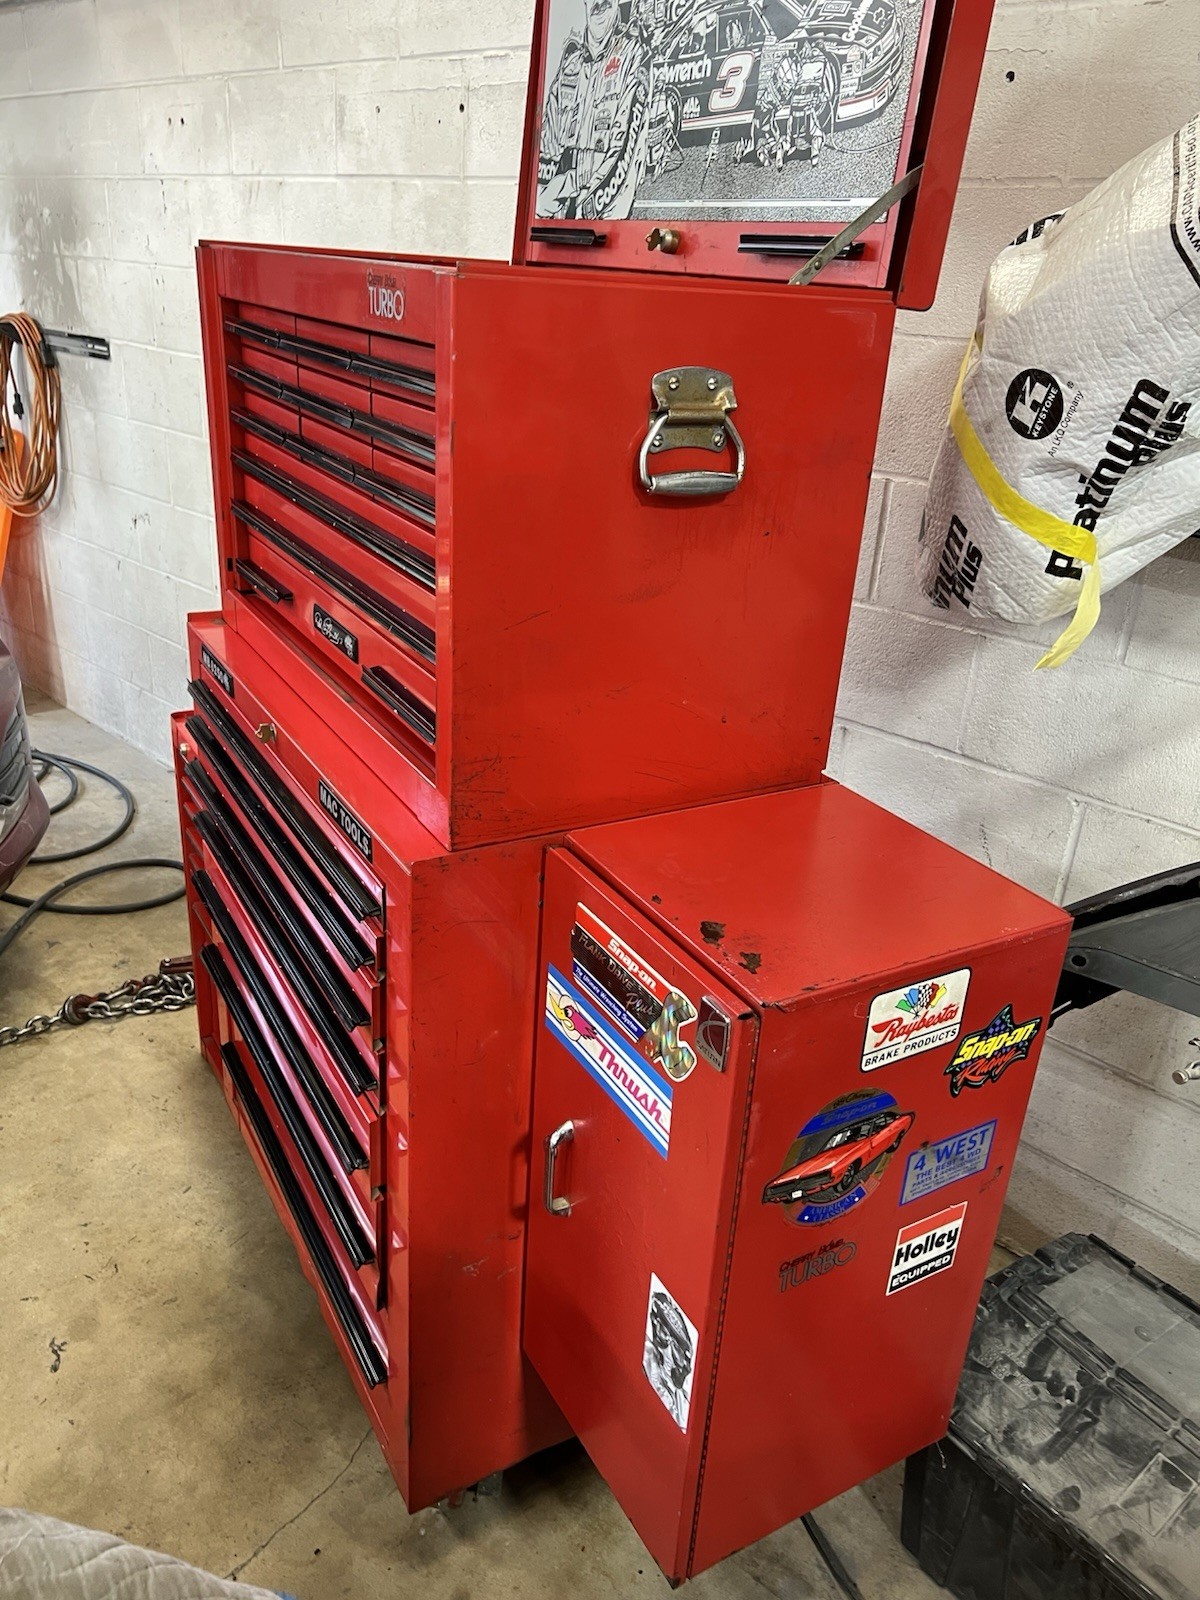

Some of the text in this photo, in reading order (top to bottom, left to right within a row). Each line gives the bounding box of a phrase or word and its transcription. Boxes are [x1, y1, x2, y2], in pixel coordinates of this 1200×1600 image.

[708, 51, 755, 112] 3
[368, 286, 404, 320] TURBO
[1031, 386, 1059, 437] KEYSTONE
[1047, 390, 1084, 458] An LKQ Company
[1045, 379, 1170, 580] patinum
[320, 785, 369, 856] MAC TOOLS
[578, 933, 635, 990] FLANK DRIVE
[864, 1027, 958, 1068] BRAKE PRODUCTS
[871, 1003, 960, 1048] Raybestos
[952, 1023, 1036, 1066] Snap-on
[598, 1044, 662, 1122] Thrush
[913, 1128, 990, 1171] 4 WEST
[915, 1167, 934, 1181] THE
[779, 1241, 857, 1294] TURBO
[891, 1254, 951, 1287] EQUIPPED
[894, 1227, 959, 1267] Holley
